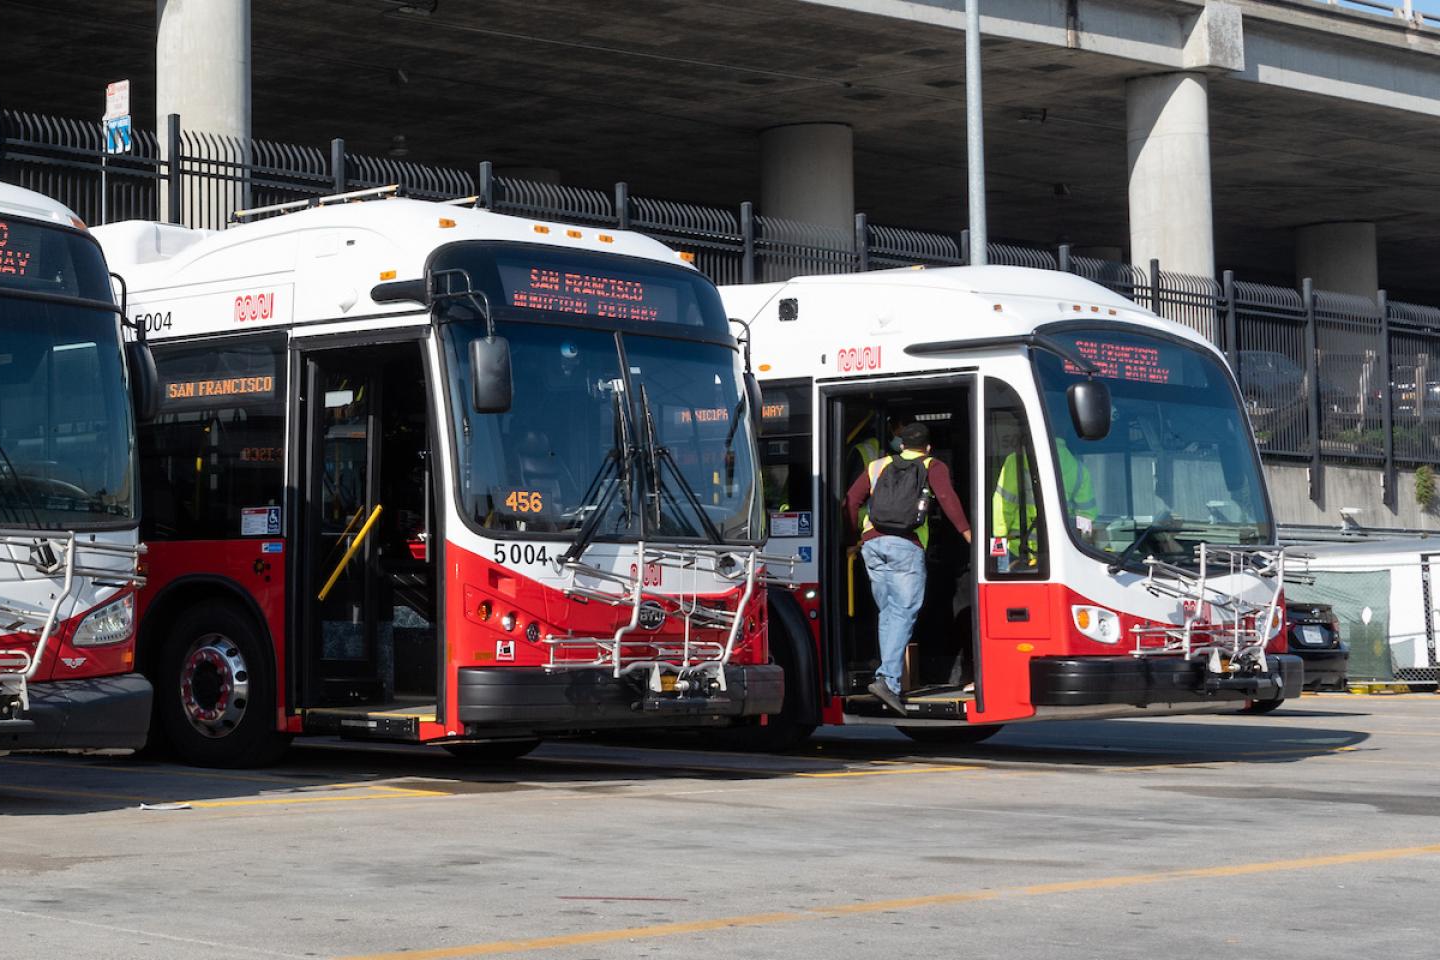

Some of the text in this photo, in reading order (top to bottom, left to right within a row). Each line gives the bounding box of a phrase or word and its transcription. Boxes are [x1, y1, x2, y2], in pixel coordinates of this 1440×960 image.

[529, 268, 643, 301] SAN FRANCISCO
[169, 377, 272, 398] SAN FRANCISCO
[505, 491, 543, 513] 456
[494, 543, 548, 566] 5004
